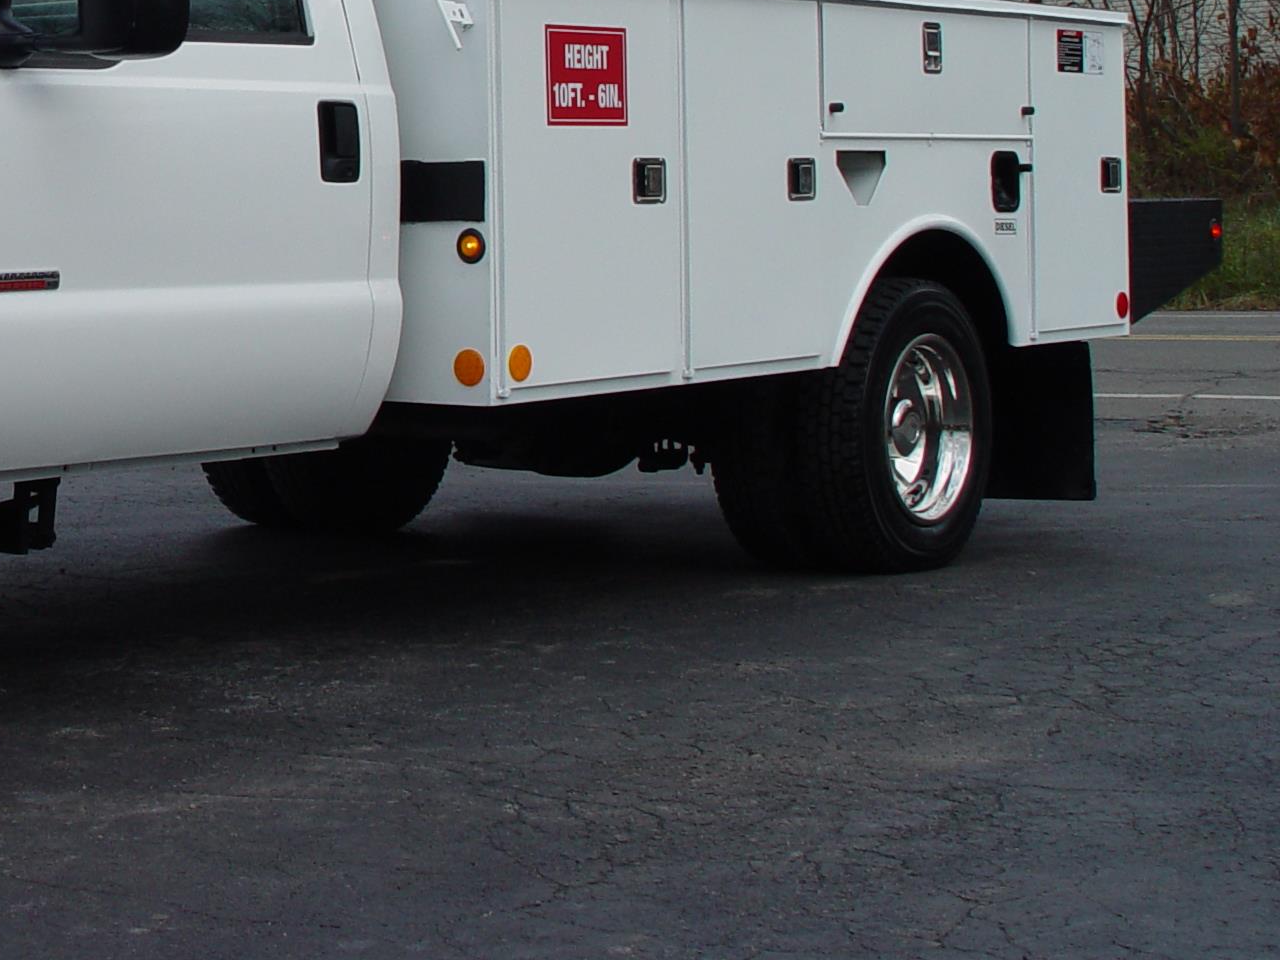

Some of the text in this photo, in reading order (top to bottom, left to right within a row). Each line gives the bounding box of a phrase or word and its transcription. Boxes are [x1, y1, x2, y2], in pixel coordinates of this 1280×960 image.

[564, 43, 609, 70] HEIGHT
[553, 82, 585, 108] 10FT.
[597, 83, 622, 109] 6IN.
